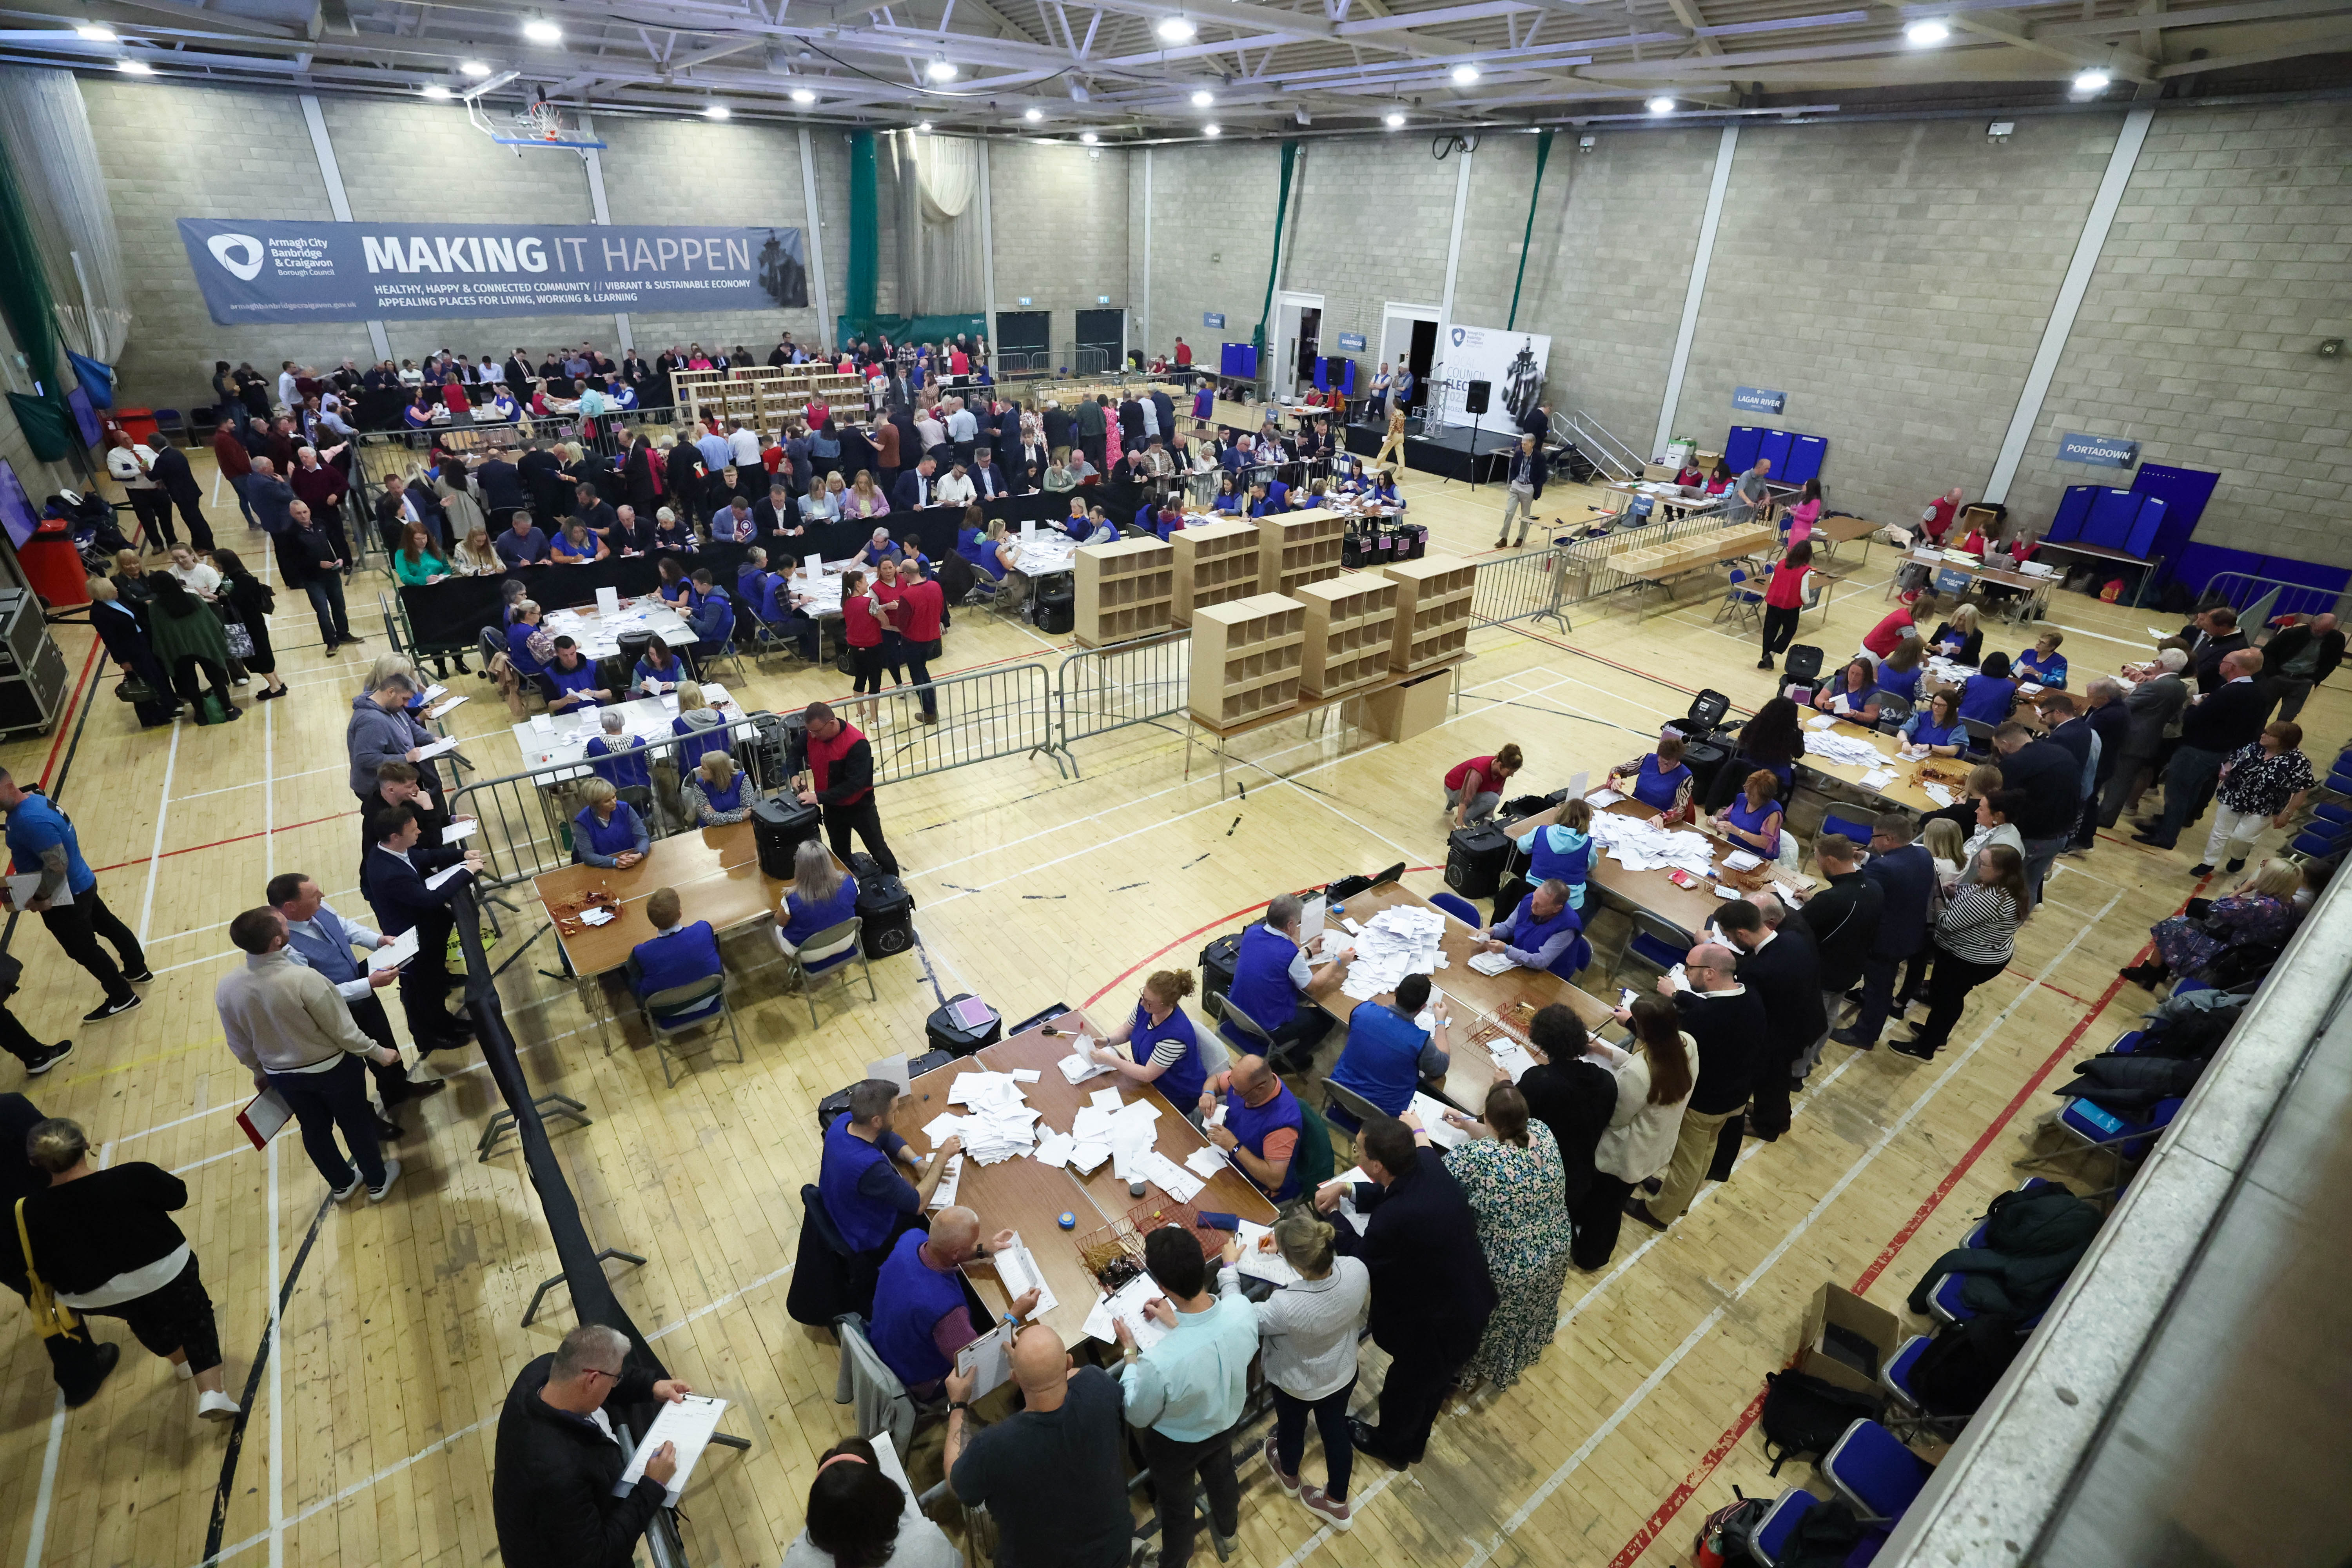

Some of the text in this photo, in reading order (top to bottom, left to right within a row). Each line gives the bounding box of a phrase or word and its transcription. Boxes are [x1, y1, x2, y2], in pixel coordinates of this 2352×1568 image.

[269, 238, 327, 249] Armagh City
[271, 249, 322, 259] Banbridge
[361, 236, 751, 273] MAKING IT HAPPEN
[275, 258, 333, 269] & Craigavon
[374, 284, 424, 295] HEALTHY,
[426, 284, 459, 294] HAPPY
[463, 284, 471, 293] &
[473, 283, 532, 293] CONNECTED
[534, 282, 590, 292] COMMUNITY
[605, 281, 643, 290] VIBRANT
[645, 281, 653, 289] &
[654, 280, 710, 289] SUSTAINABLE
[711, 279, 751, 288] ECONOMY
[230, 301, 357, 310] armaghbanbridgecraigavon.gov.uk
[378, 293, 638, 307] APPEALING PLACES FOR LIVING, WORKING & LEARNING
[1738, 395, 1760, 404] LAGAN
[1761, 398, 1781, 407] RIVER
[2067, 444, 2131, 460] PORTADOWN
